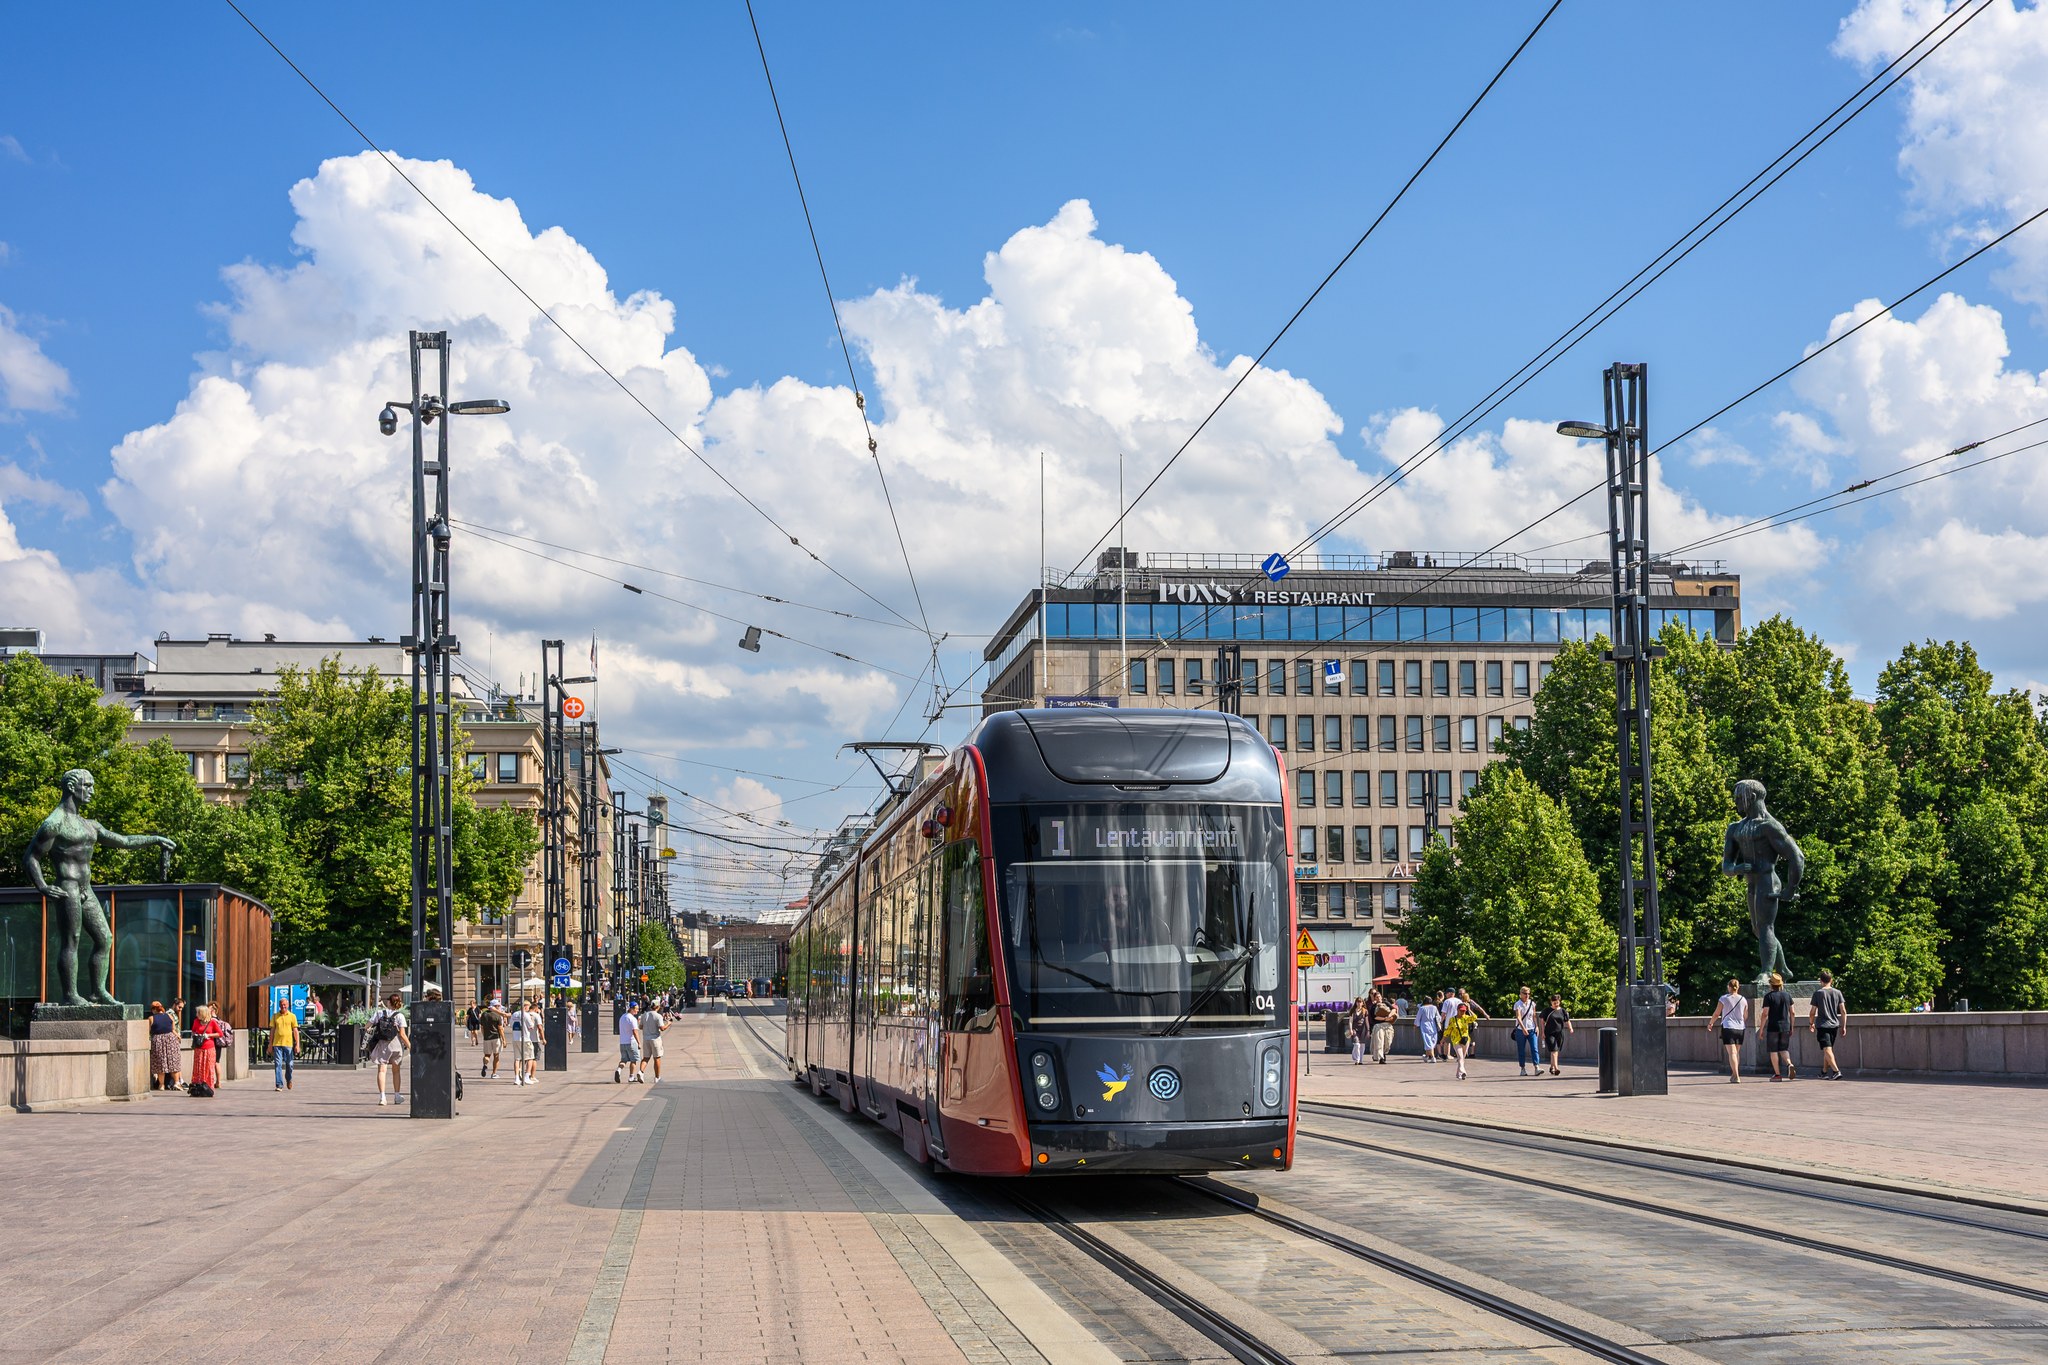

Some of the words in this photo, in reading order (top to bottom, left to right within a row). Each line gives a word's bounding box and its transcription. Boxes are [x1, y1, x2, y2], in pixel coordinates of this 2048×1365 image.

[1254, 591, 1376, 605] RESTAURANT
[1051, 820, 1070, 856] 1
[1256, 995, 1275, 1010] 04
